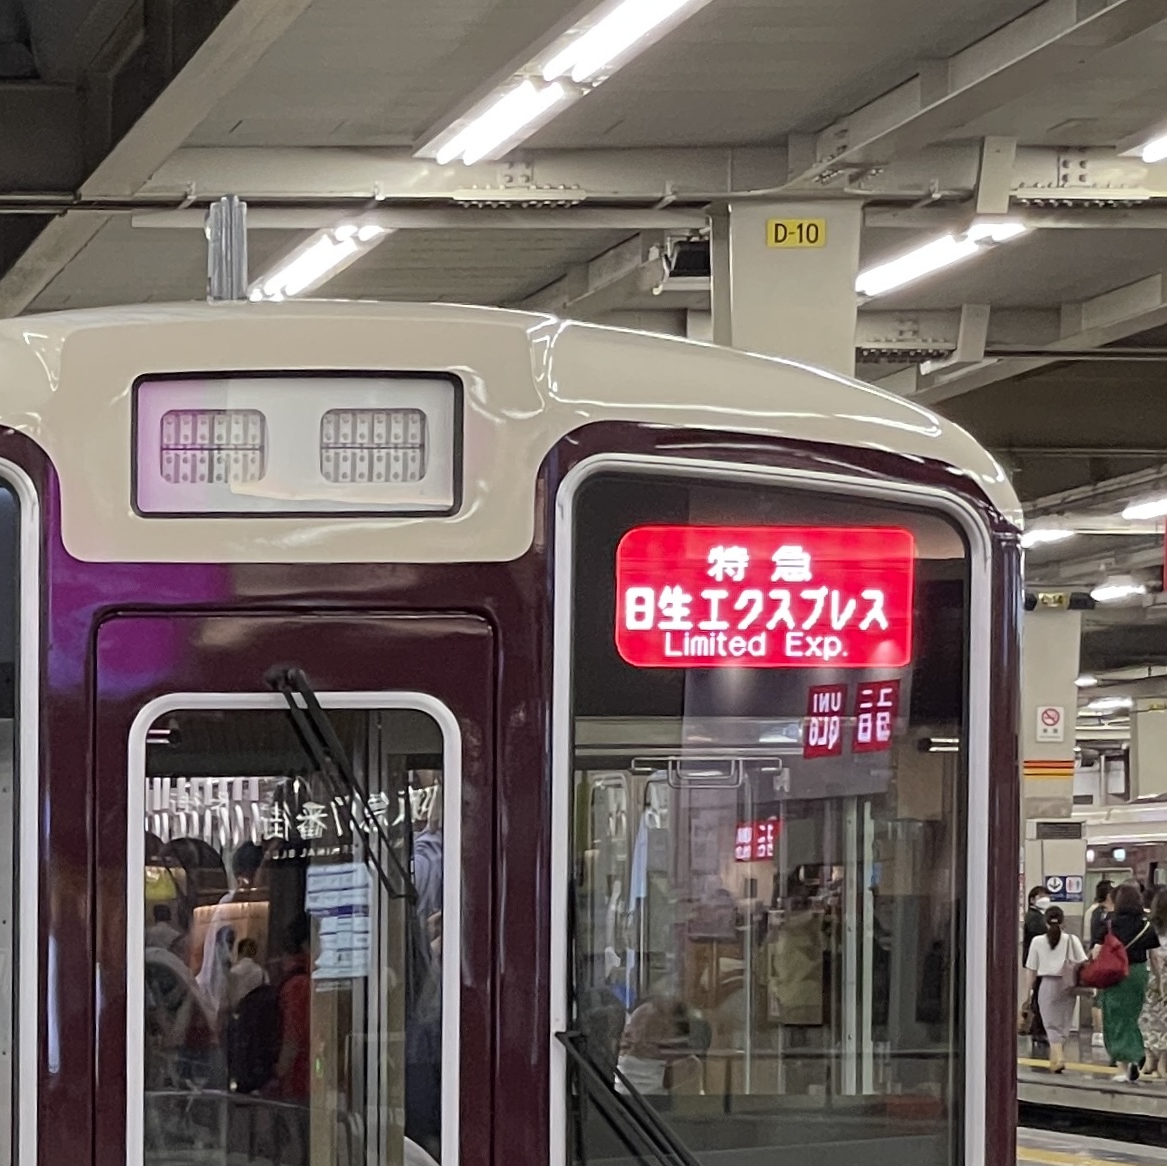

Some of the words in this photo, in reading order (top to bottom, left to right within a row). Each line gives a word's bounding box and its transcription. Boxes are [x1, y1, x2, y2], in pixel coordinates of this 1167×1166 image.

[773, 223, 819, 244] D-10
[707, 545, 813, 582] 特急
[624, 585, 889, 631] 日生エクスプレス
[664, 631, 766, 657] Limited
[785, 631, 849, 661] Exp.
